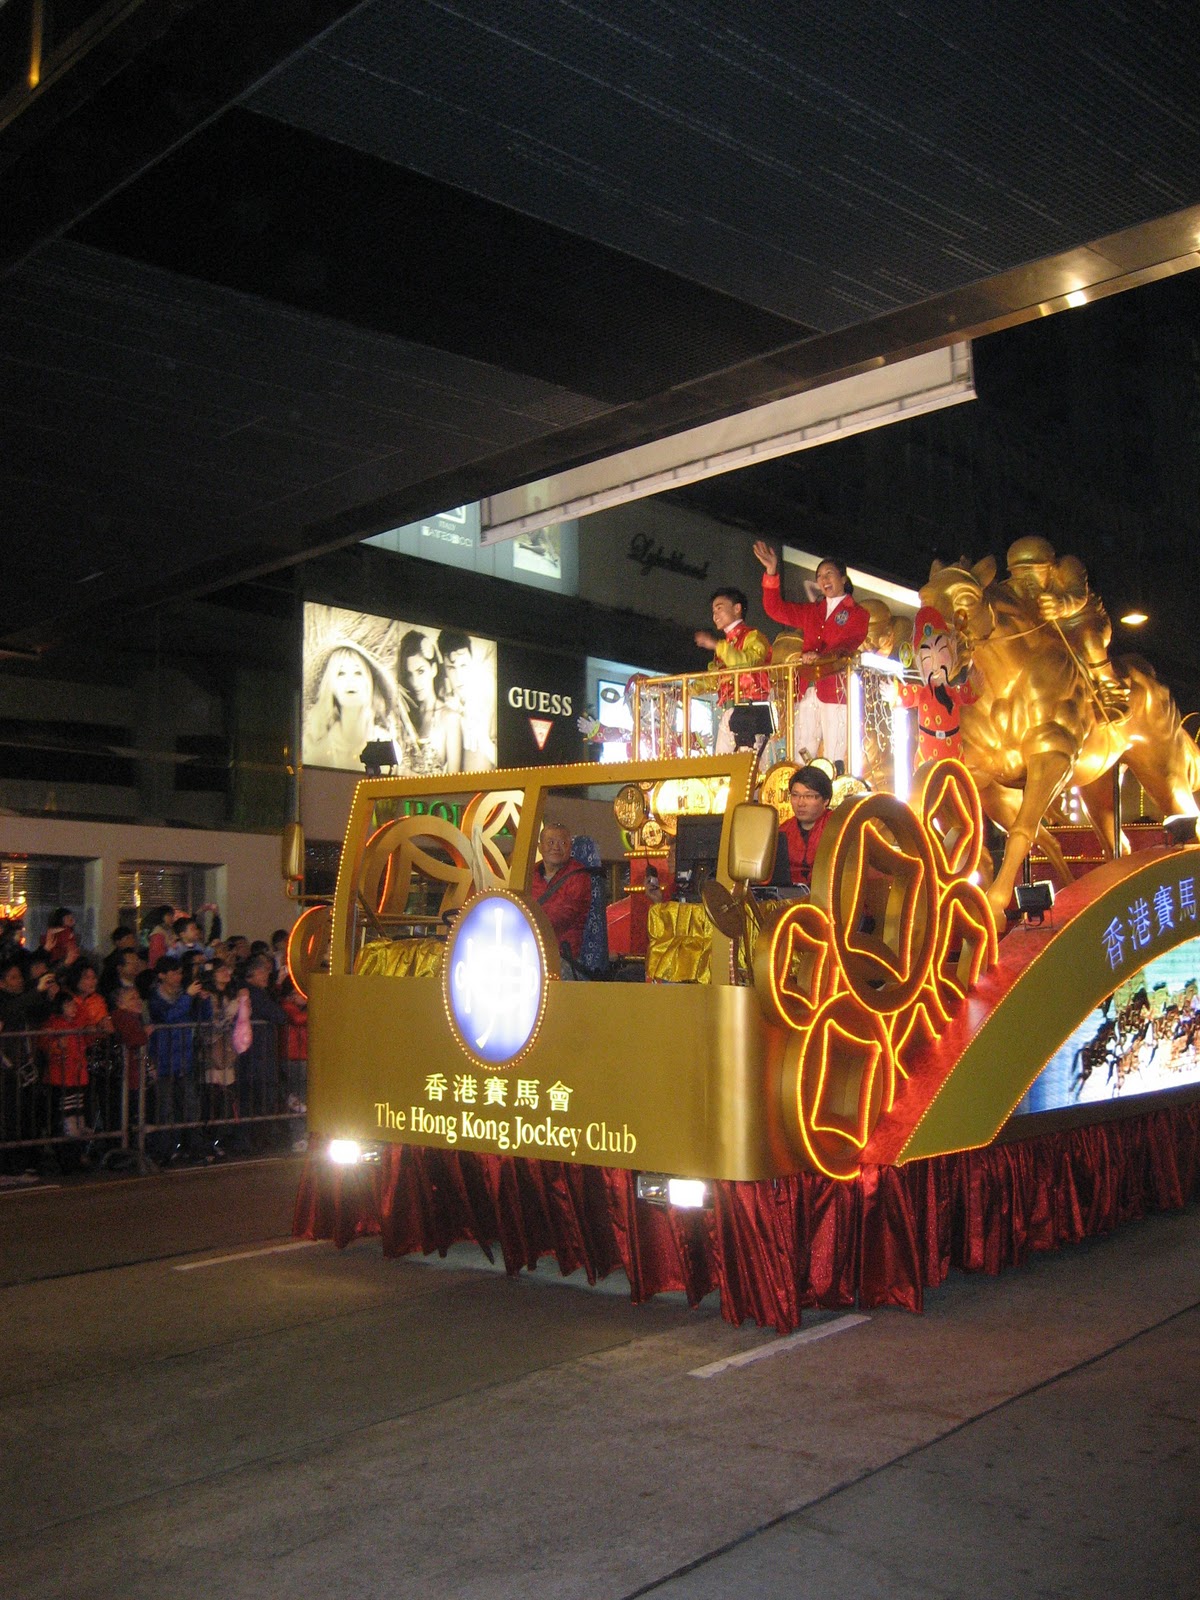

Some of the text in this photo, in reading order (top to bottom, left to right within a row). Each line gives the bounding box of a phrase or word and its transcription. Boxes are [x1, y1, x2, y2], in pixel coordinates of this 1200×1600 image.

[508, 686, 572, 716] GUESS
[1102, 877, 1196, 970] 香港賽馬
[424, 1072, 574, 1112] 香港賽馬會
[374, 1103, 637, 1156] The Hong Kong Jockey Club
